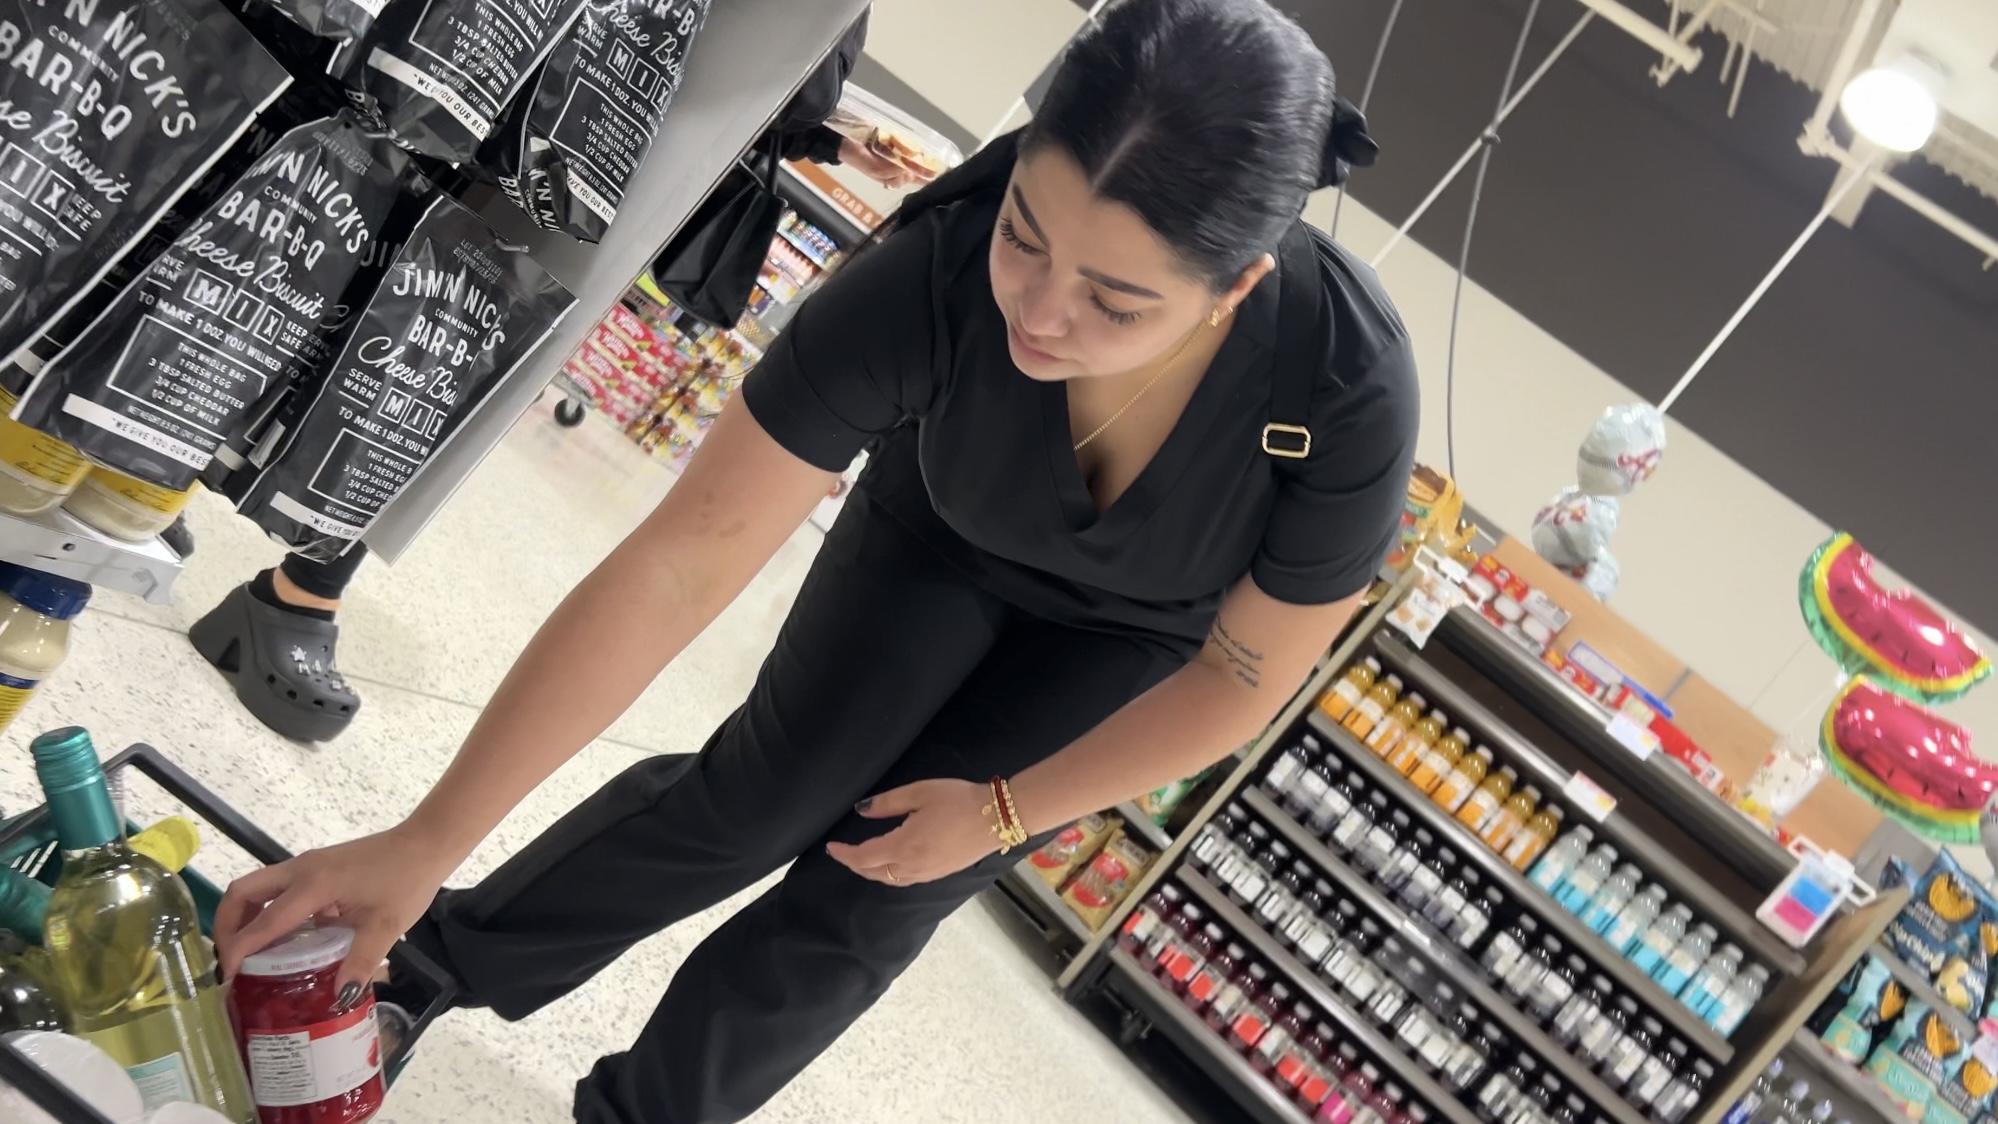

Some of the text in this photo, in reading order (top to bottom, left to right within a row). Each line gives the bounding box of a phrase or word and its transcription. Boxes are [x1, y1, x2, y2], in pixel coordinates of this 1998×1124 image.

[447, 16, 455, 26] 3
[456, 20, 480, 42] TBSP
[454, 35, 470, 50] 3/4
[474, 2, 494, 21] THIS
[494, 18, 515, 42] WHOLE
[513, 37, 524, 52] BAG
[477, 20, 515, 59] 1 FRESH EGG
[577, 25, 604, 50] WARM
[582, 17, 608, 40] SRVE
[103, 10, 197, 138] NICK'S
[452, 49, 466, 65] 1/2
[475, 66, 489, 79] OF
[574, 54, 587, 69] TO
[586, 64, 611, 88] MAKE
[631, 99, 647, 117] YOU
[453, 102, 472, 122] OUR
[471, 118, 487, 136] BES
[581, 115, 588, 124] 3
[588, 119, 604, 135] TBSP
[603, 131, 625, 154] SALTED
[600, 102, 613, 118] THIS
[613, 113, 634, 137] WHOLE
[601, 117, 636, 151] 1 FRESH EGG
[31, 109, 131, 203] Biscuit
[586, 132, 597, 144] 3/4
[597, 140, 610, 154] CUP
[585, 144, 625, 183] 1/2 CUP OF MILK
[264, 185, 317, 224] COMMUNITY
[307, 165, 369, 254] NICK'S
[580, 183, 591, 199] YOU
[590, 193, 602, 209] OUR
[832, 187, 864, 215] GRAB
[174, 218, 255, 276] heese
[217, 190, 325, 271] BAR-B-Q
[253, 255, 325, 319] Biscuit
[138, 290, 155, 306] TO
[156, 297, 195, 325] MAKE
[196, 317, 203, 330] 1
[224, 332, 247, 351] YOU
[286, 320, 308, 338] KEEP
[435, 307, 480, 338] COMMUNITY
[280, 331, 303, 350] SAFE
[407, 314, 480, 372] BAR-B-
[178, 342, 198, 358] THIS
[228, 369, 247, 382] BAG
[180, 358, 232, 389] 1 FRESH EGG
[358, 336, 425, 389] Cheese
[148, 357, 245, 410] 3 TBSP SALTED BUTTER
[343, 377, 377, 401] WARM
[348, 368, 383, 391] SERVE
[164, 394, 184, 408] CUP
[183, 402, 198, 414] OF
[197, 409, 221, 427] MILK
[170, 383, 188, 396] CUP
[188, 391, 230, 417] CHEDDAR
[338, 405, 354, 420] TO
[353, 415, 383, 436] MAKE
[382, 428, 387, 437] 1
[386, 430, 404, 447] DOZ.
[404, 436, 421, 453] YOU
[190, 452, 208, 467] BES
[367, 449, 384, 462] THIS
[383, 456, 407, 473] WHOLE
[372, 464, 394, 479] FRESH
[343, 464, 351, 472] 3
[351, 467, 370, 480] TBSP
[370, 475, 394, 491] SALTED
[348, 479, 361, 490] 3/4
[361, 484, 376, 495] CUP
[345, 490, 381, 508] 1/2 CUP OF
